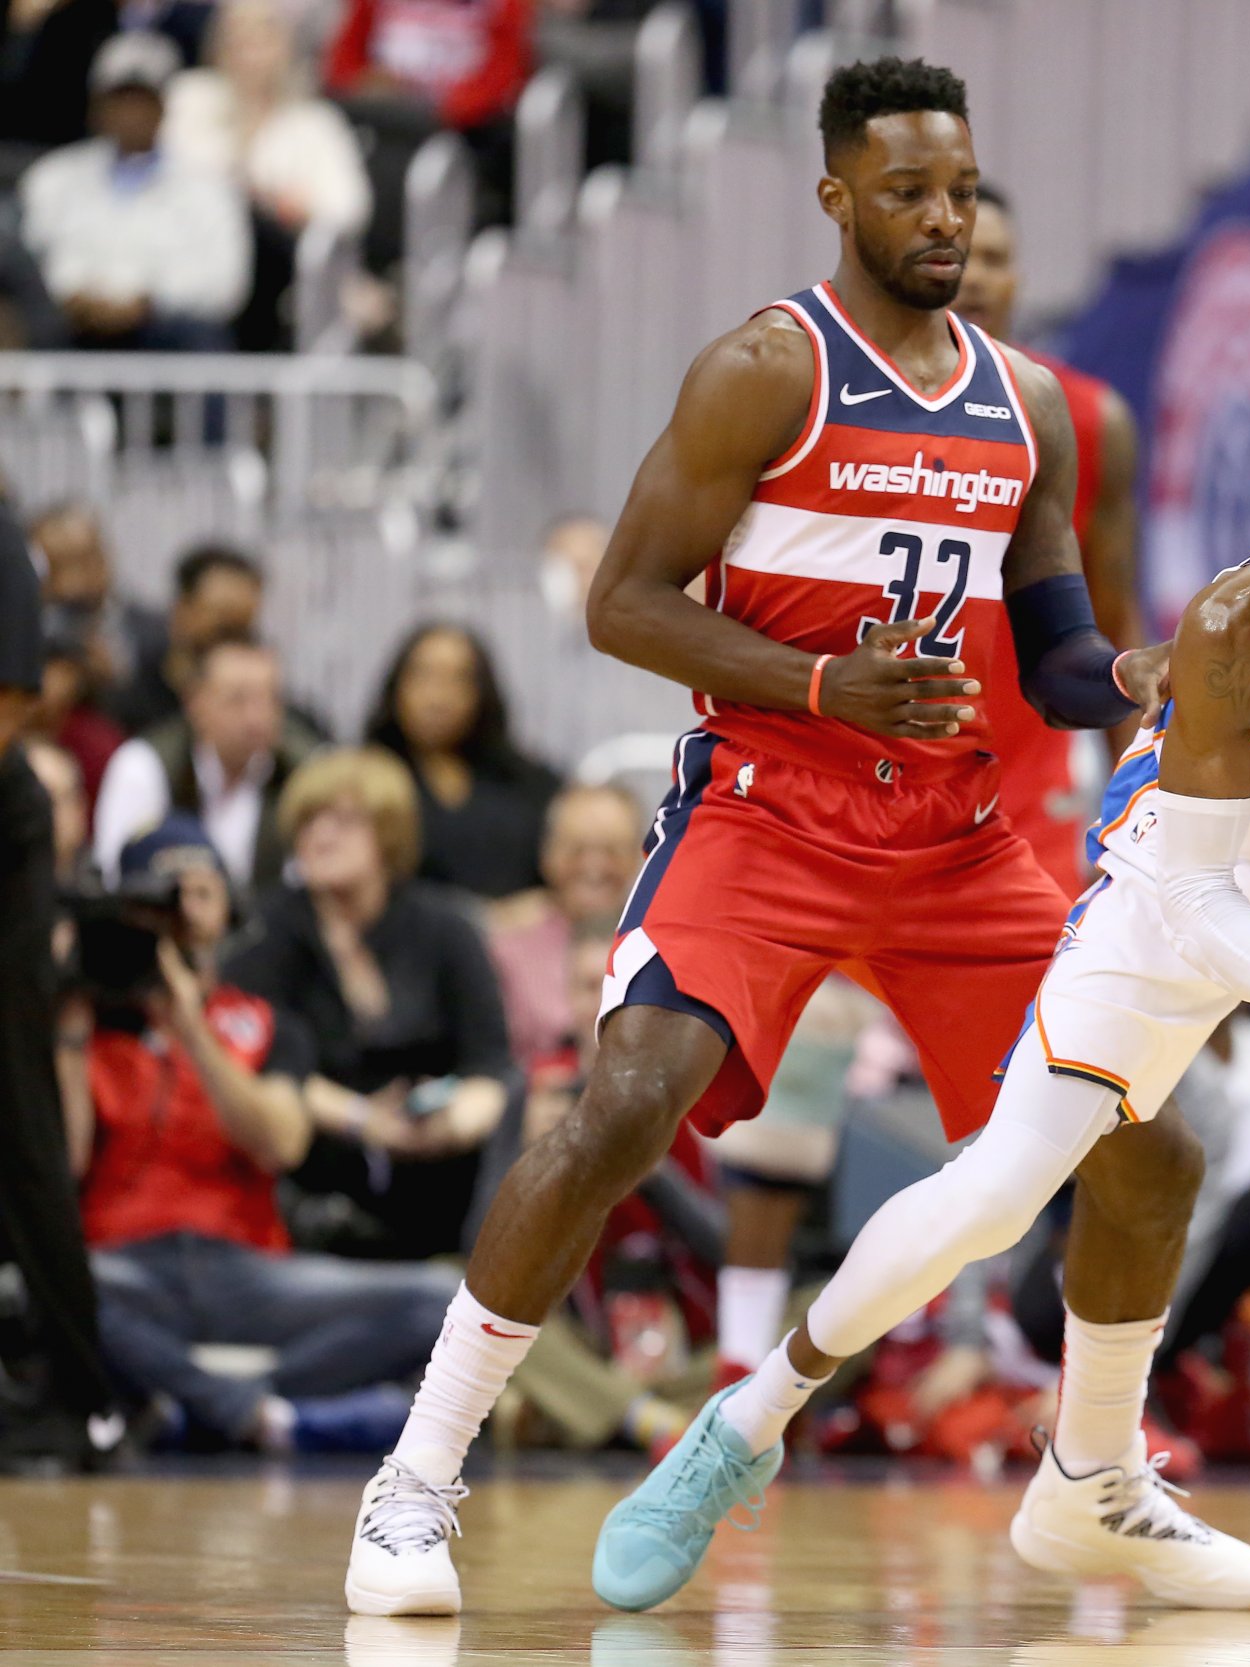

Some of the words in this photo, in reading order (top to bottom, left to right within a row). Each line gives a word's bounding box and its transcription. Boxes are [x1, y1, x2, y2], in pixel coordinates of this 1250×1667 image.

[964, 402, 1012, 420] GEICO
[829, 451, 1023, 513] washington
[856, 531, 971, 660] 32
